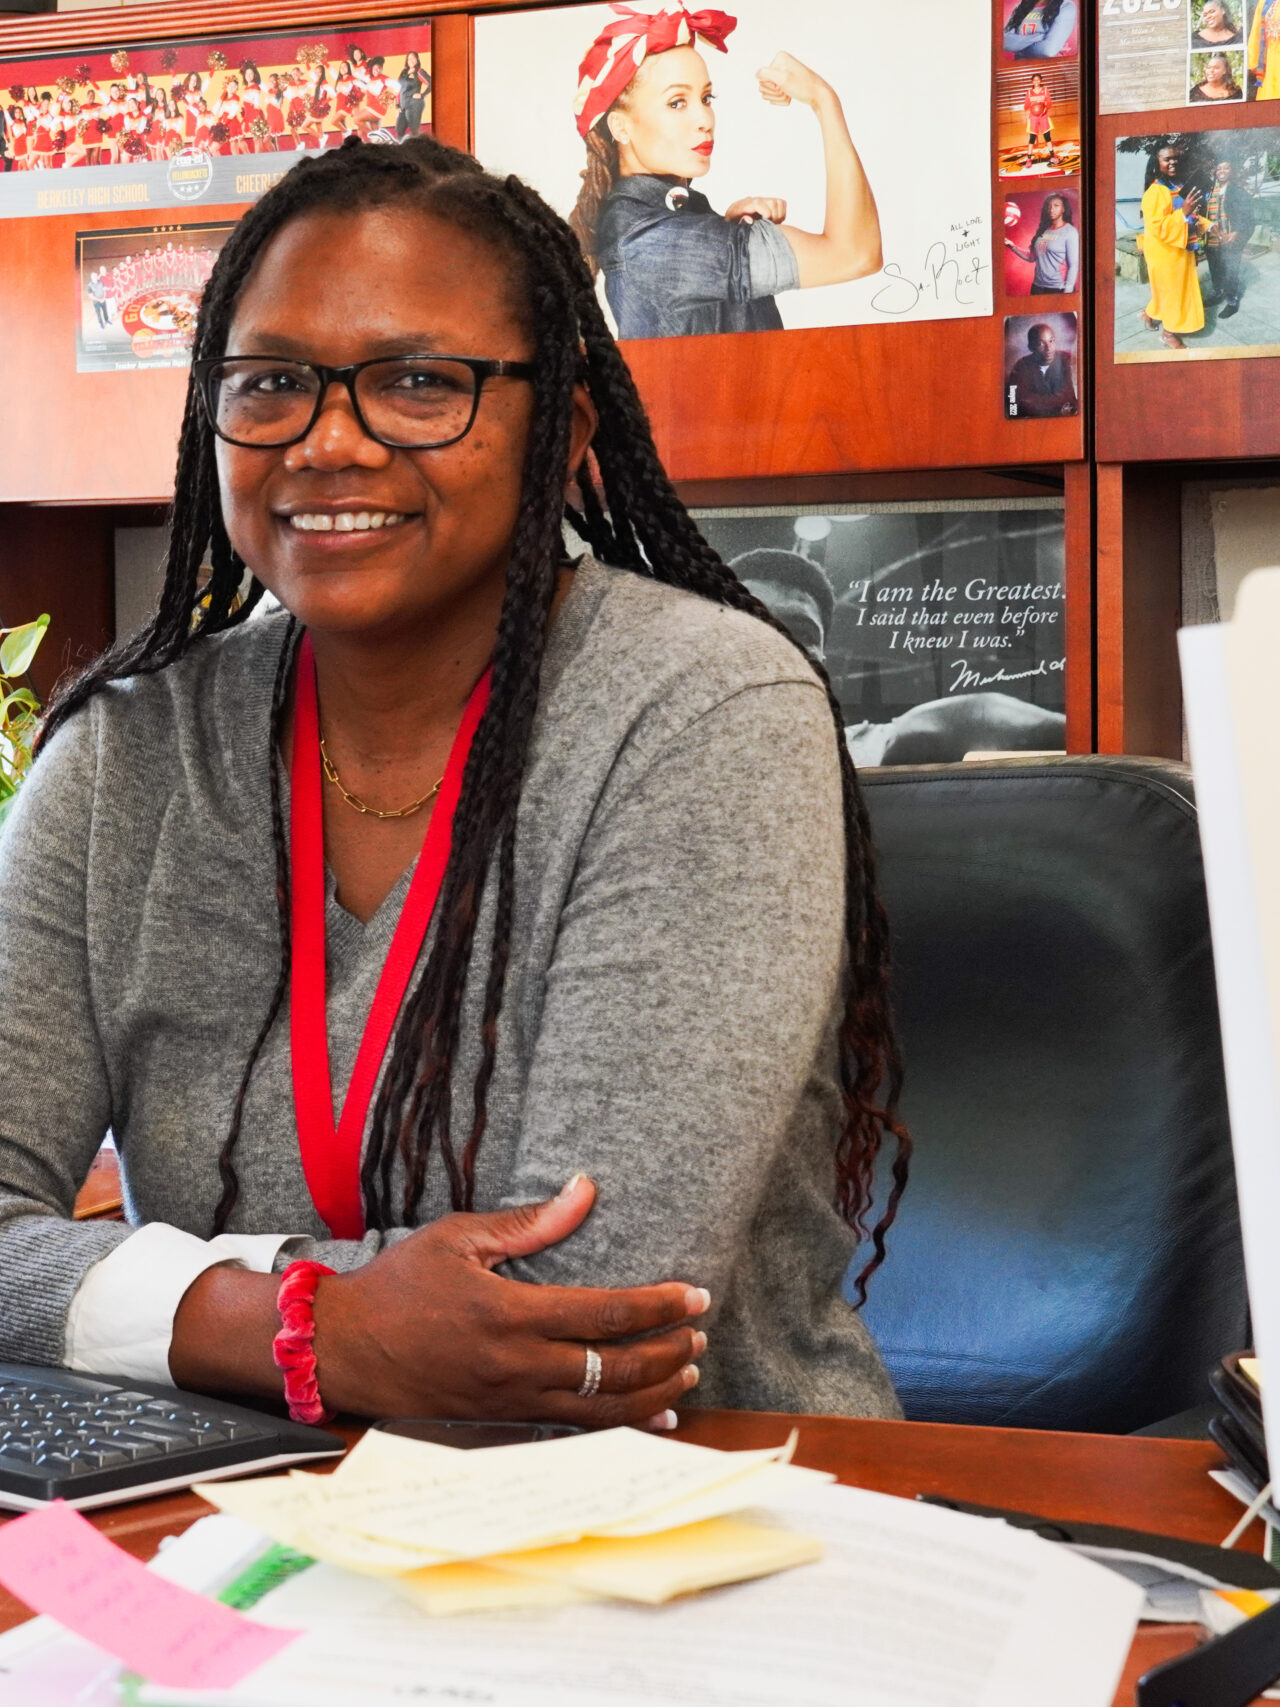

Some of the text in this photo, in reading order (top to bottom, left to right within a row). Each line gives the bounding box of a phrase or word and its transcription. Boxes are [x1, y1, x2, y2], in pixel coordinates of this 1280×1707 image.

[37, 184, 150, 209] BERKELEY HIGH SCHOOL
[950, 216, 983, 232] ALL LOVE
[956, 238, 981, 252] LIGHT
[876, 586, 913, 602] am
[921, 579, 957, 602] the
[965, 578, 1066, 601] Greatest.
[856, 606, 1059, 629] I said that even before
[889, 631, 900, 649] I
[903, 631, 953, 654] knew
[958, 630, 969, 649] I
